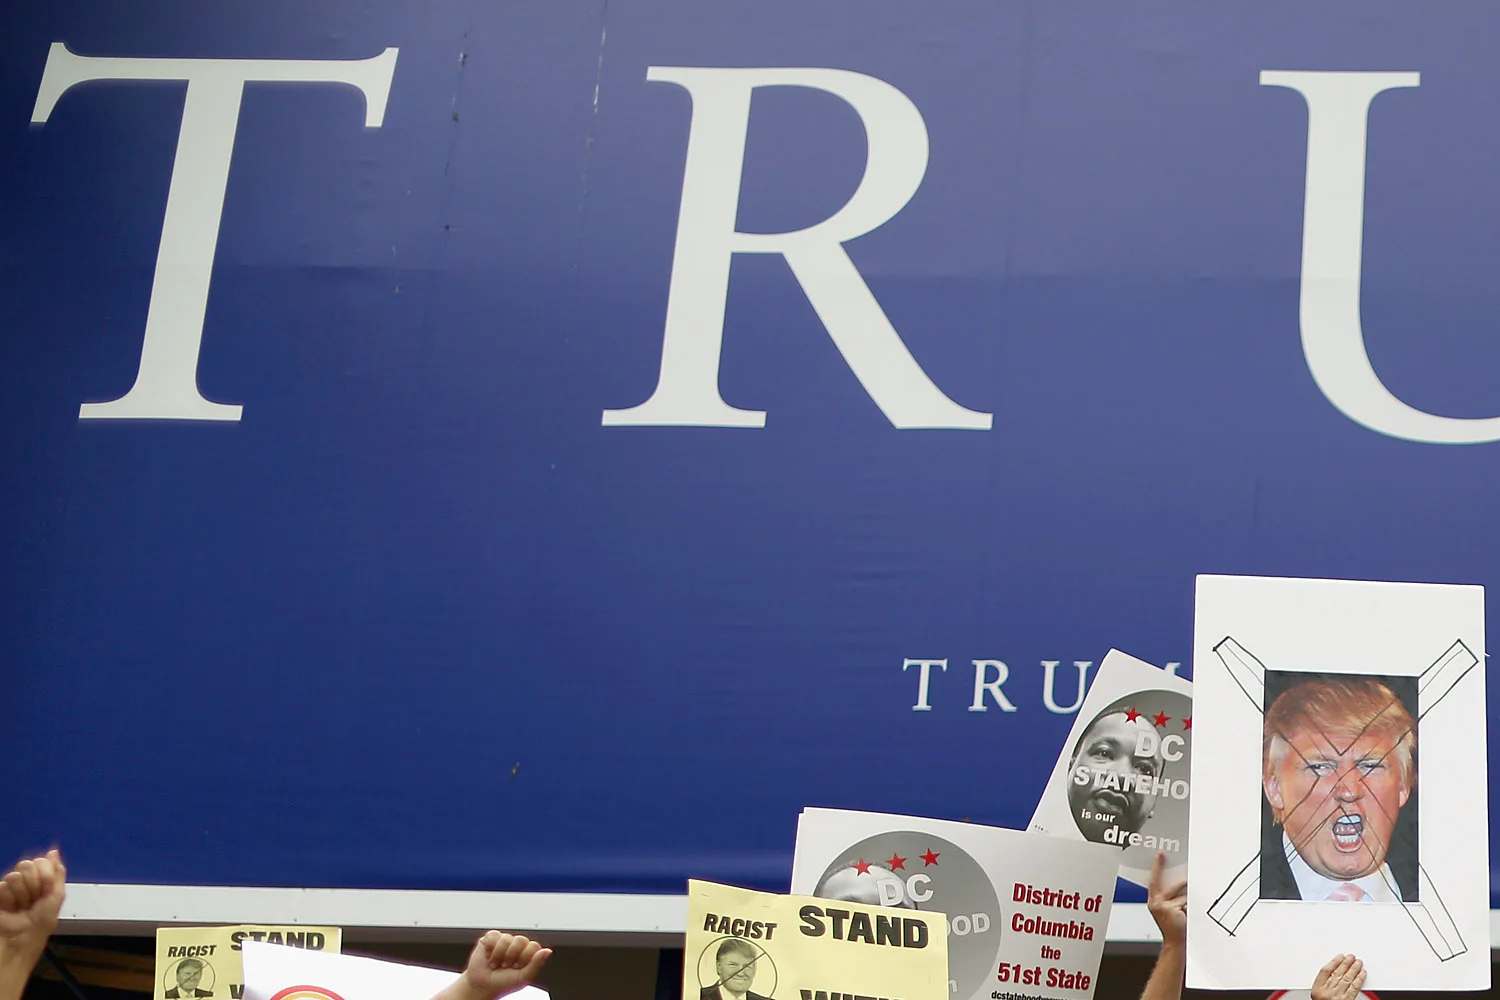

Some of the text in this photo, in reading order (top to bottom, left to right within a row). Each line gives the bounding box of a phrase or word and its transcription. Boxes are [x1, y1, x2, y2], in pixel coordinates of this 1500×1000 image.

[1134, 731, 1185, 762] DC
[1074, 765, 1189, 799] STATEHO
[1081, 808, 1115, 823] is our
[1104, 825, 1180, 852] dream
[877, 873, 934, 908] DC
[1012, 883, 1102, 912] District of
[704, 913, 777, 940] RACIST
[799, 905, 929, 949] STAND
[1011, 913, 1094, 941] Columbia
[168, 945, 216, 958] RACIST
[230, 931, 325, 951] STAND
[1041, 945, 1061, 960] the
[997, 962, 1091, 990] 51st State
